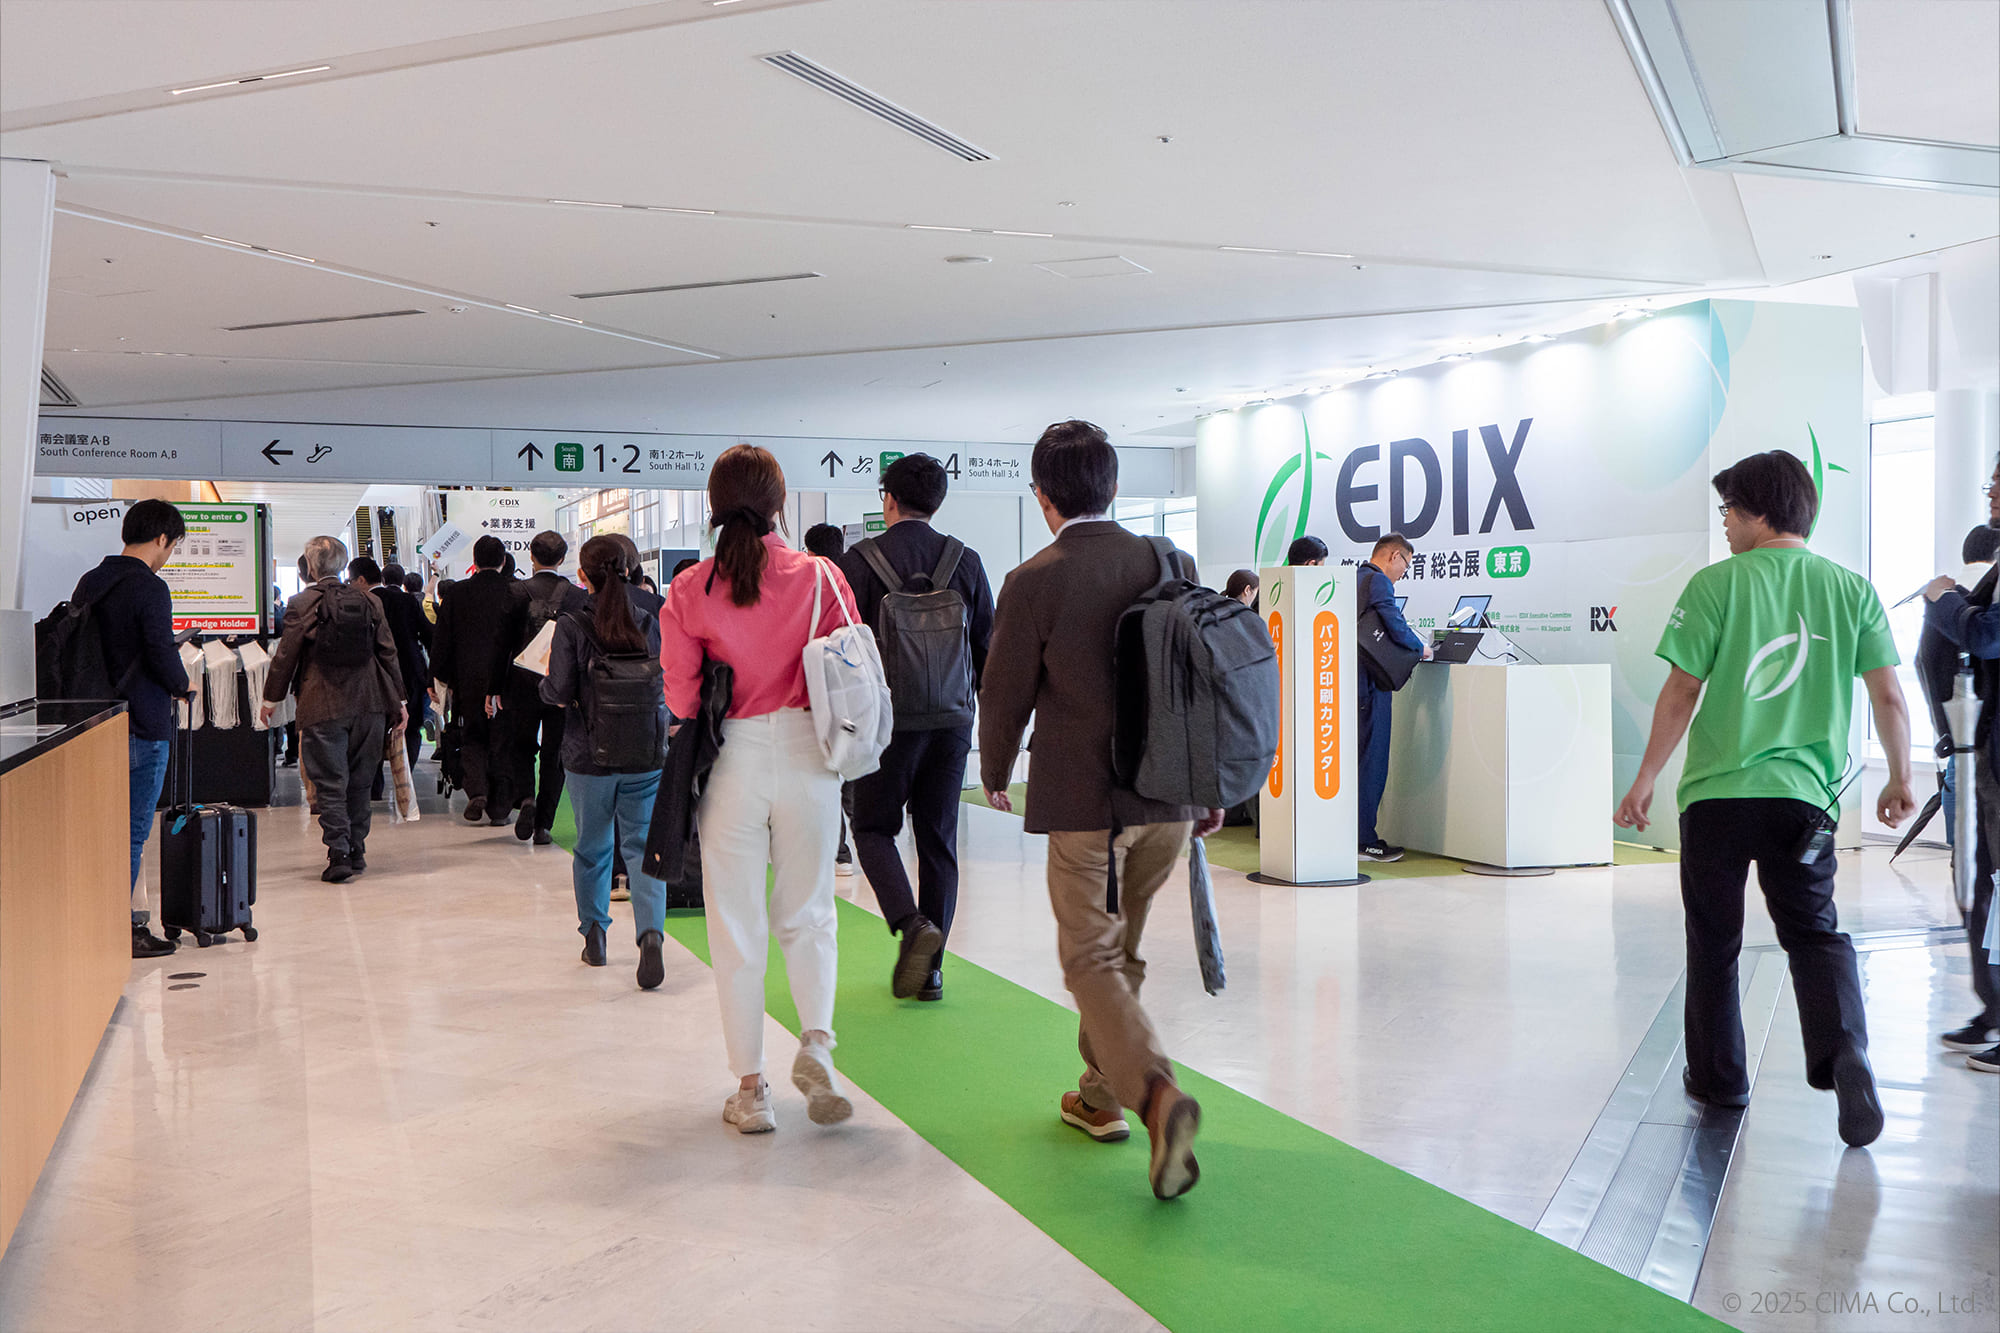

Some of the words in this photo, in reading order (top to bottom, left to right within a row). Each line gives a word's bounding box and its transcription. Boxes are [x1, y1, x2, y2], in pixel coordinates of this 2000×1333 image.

[40, 447, 69, 457] South
[72, 447, 127, 458] Conference
[130, 449, 158, 459] Room
[160, 450, 178, 460] A,B
[562, 453, 576, 469] 南
[649, 462, 672, 470] South
[675, 462, 691, 471] Hall
[694, 463, 705, 472] 1,2
[968, 469, 990, 478] South
[991, 470, 1006, 478] Hall
[1008, 470, 1020, 479] 3,4
[1335, 417, 1535, 543] EDIX
[73, 507, 121, 525] open
[490, 518, 536, 529] 業務支援
[1430, 550, 1480, 580] 総合展
[1493, 551, 1523, 574] 東京
[191, 620, 218, 630] Badge
[220, 620, 249, 628] Holder
[1418, 617, 1436, 628] 2025
[1319, 623, 1334, 787] バッジ印刷カウンター
